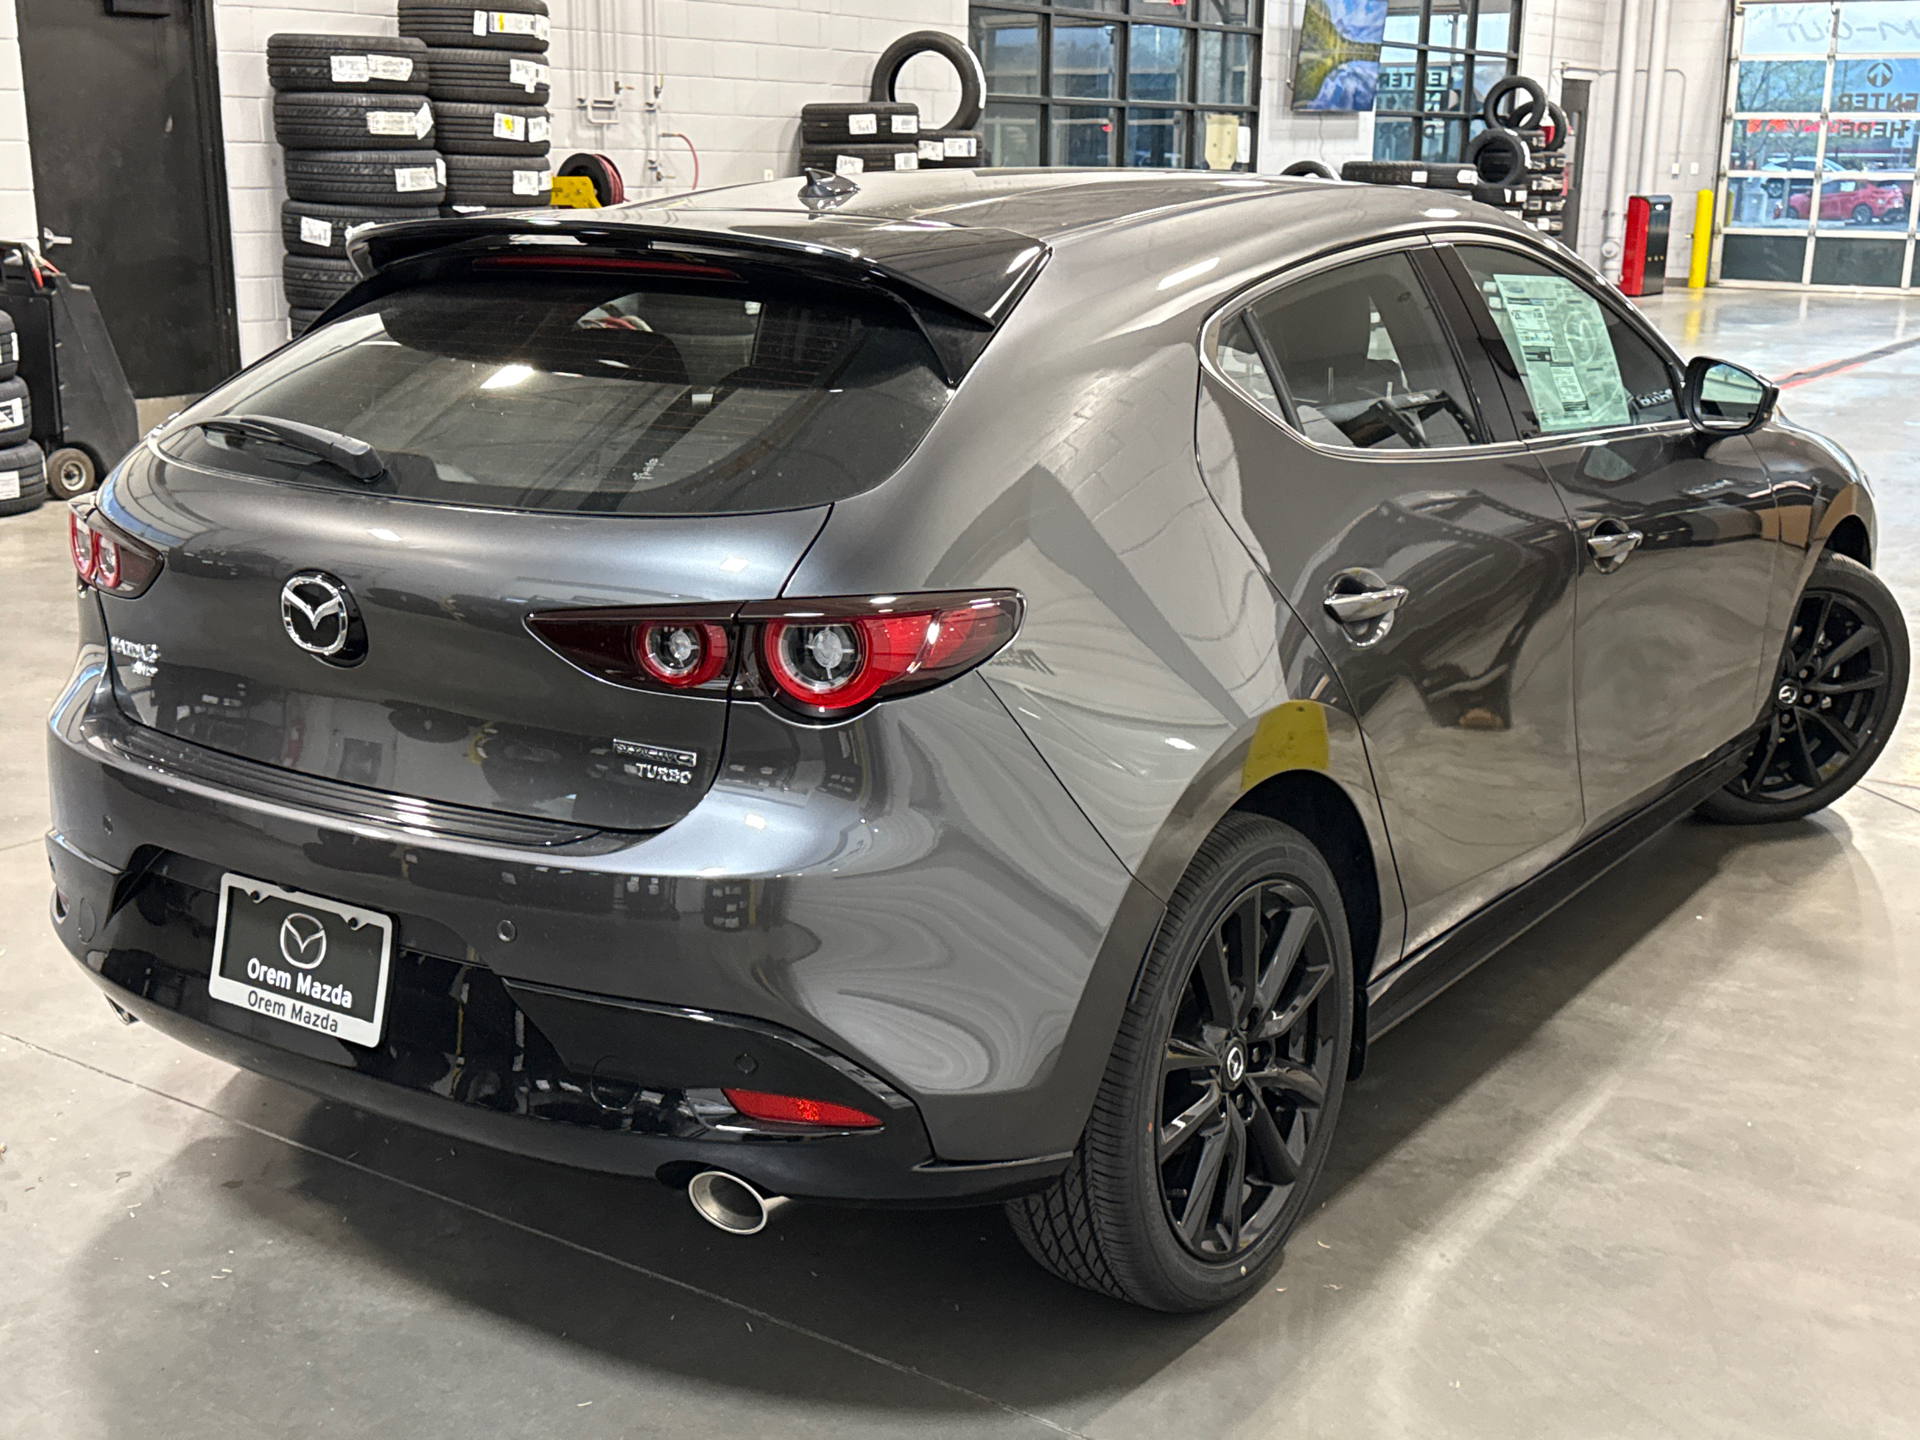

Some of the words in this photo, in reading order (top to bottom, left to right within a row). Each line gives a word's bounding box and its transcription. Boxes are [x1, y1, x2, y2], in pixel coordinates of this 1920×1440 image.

[635, 762, 692, 785] TURBO
[247, 957, 291, 990] Orem
[296, 972, 353, 1009] Mazda
[247, 990, 286, 1017] Orem
[290, 1003, 339, 1034] Mazda
